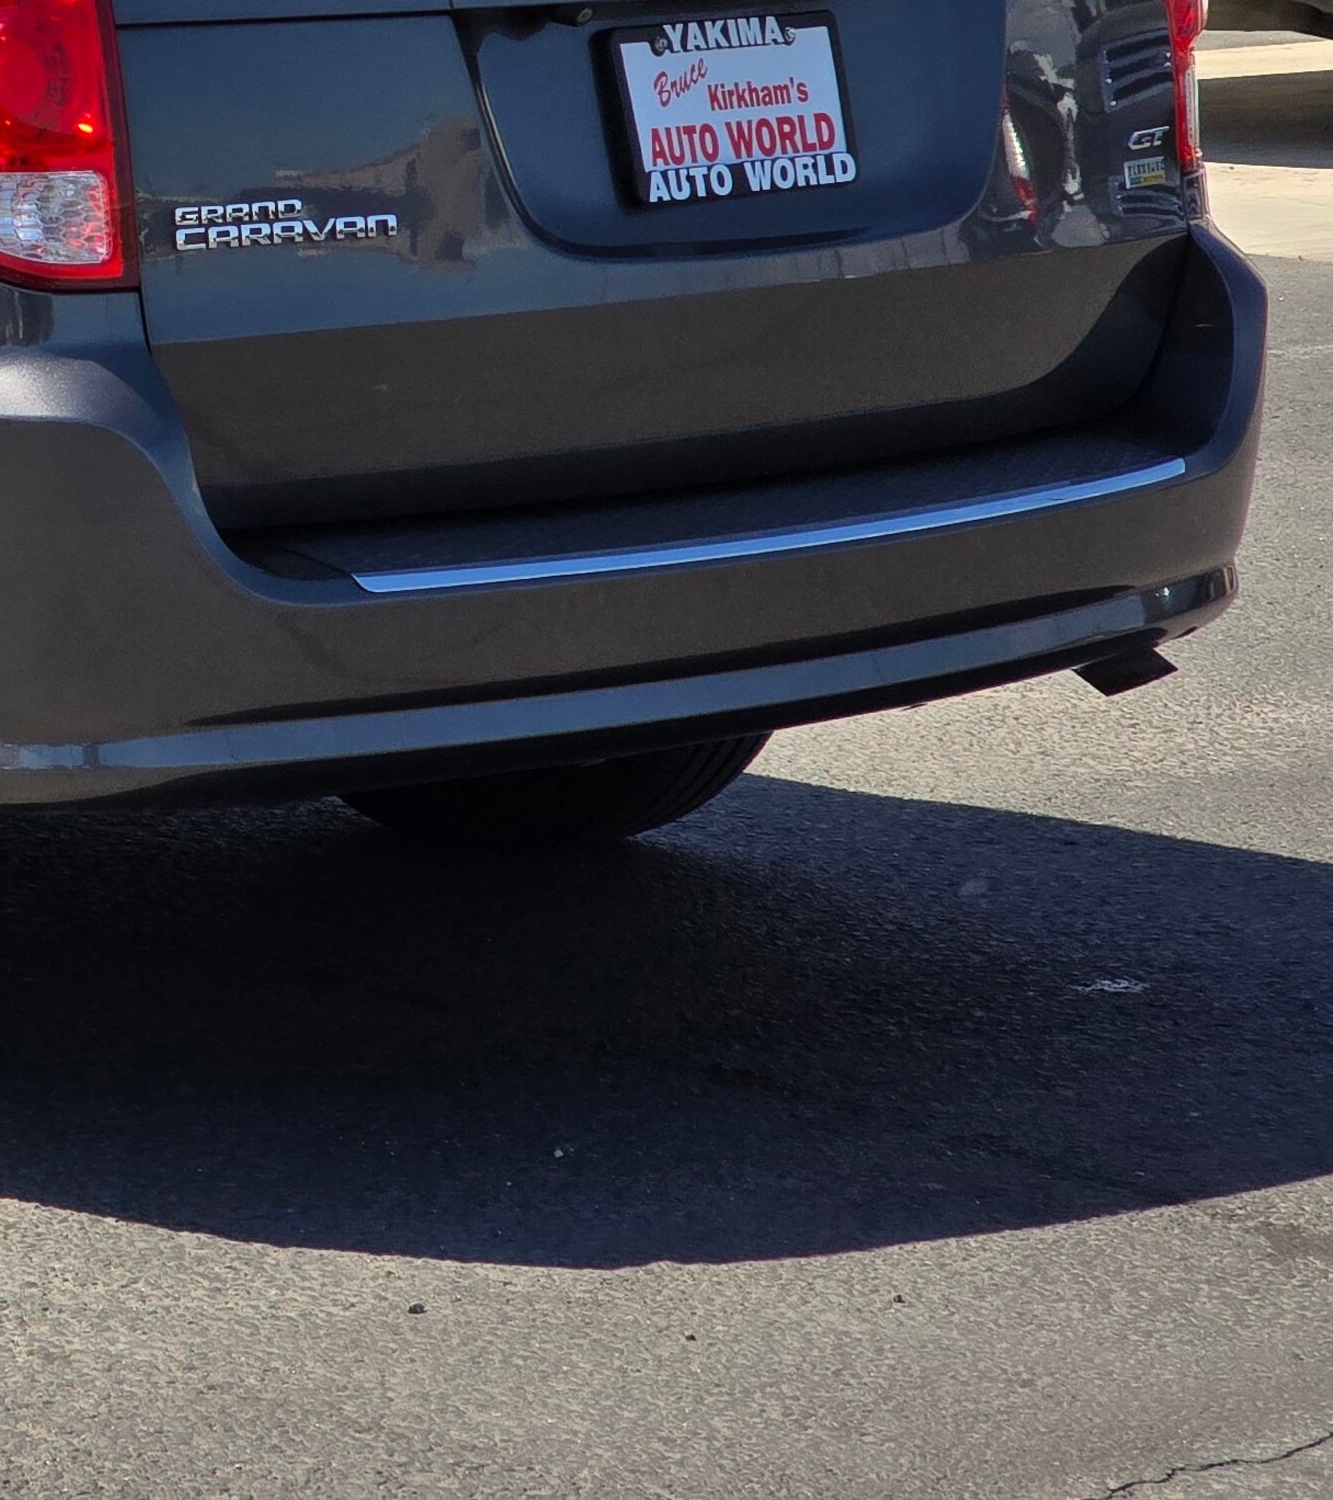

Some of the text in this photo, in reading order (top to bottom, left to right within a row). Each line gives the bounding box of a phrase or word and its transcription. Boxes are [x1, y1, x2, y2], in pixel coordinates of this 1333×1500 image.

[663, 16, 786, 54] YAKIMA
[653, 57, 708, 109] Bruce
[707, 77, 810, 112] Kirkham's
[651, 112, 836, 168] AUTO WORLD
[1127, 125, 1170, 150] GT
[649, 152, 857, 203] AUTO WORLD
[174, 198, 303, 226] GRAND
[174, 213, 399, 252] CARAVAN
